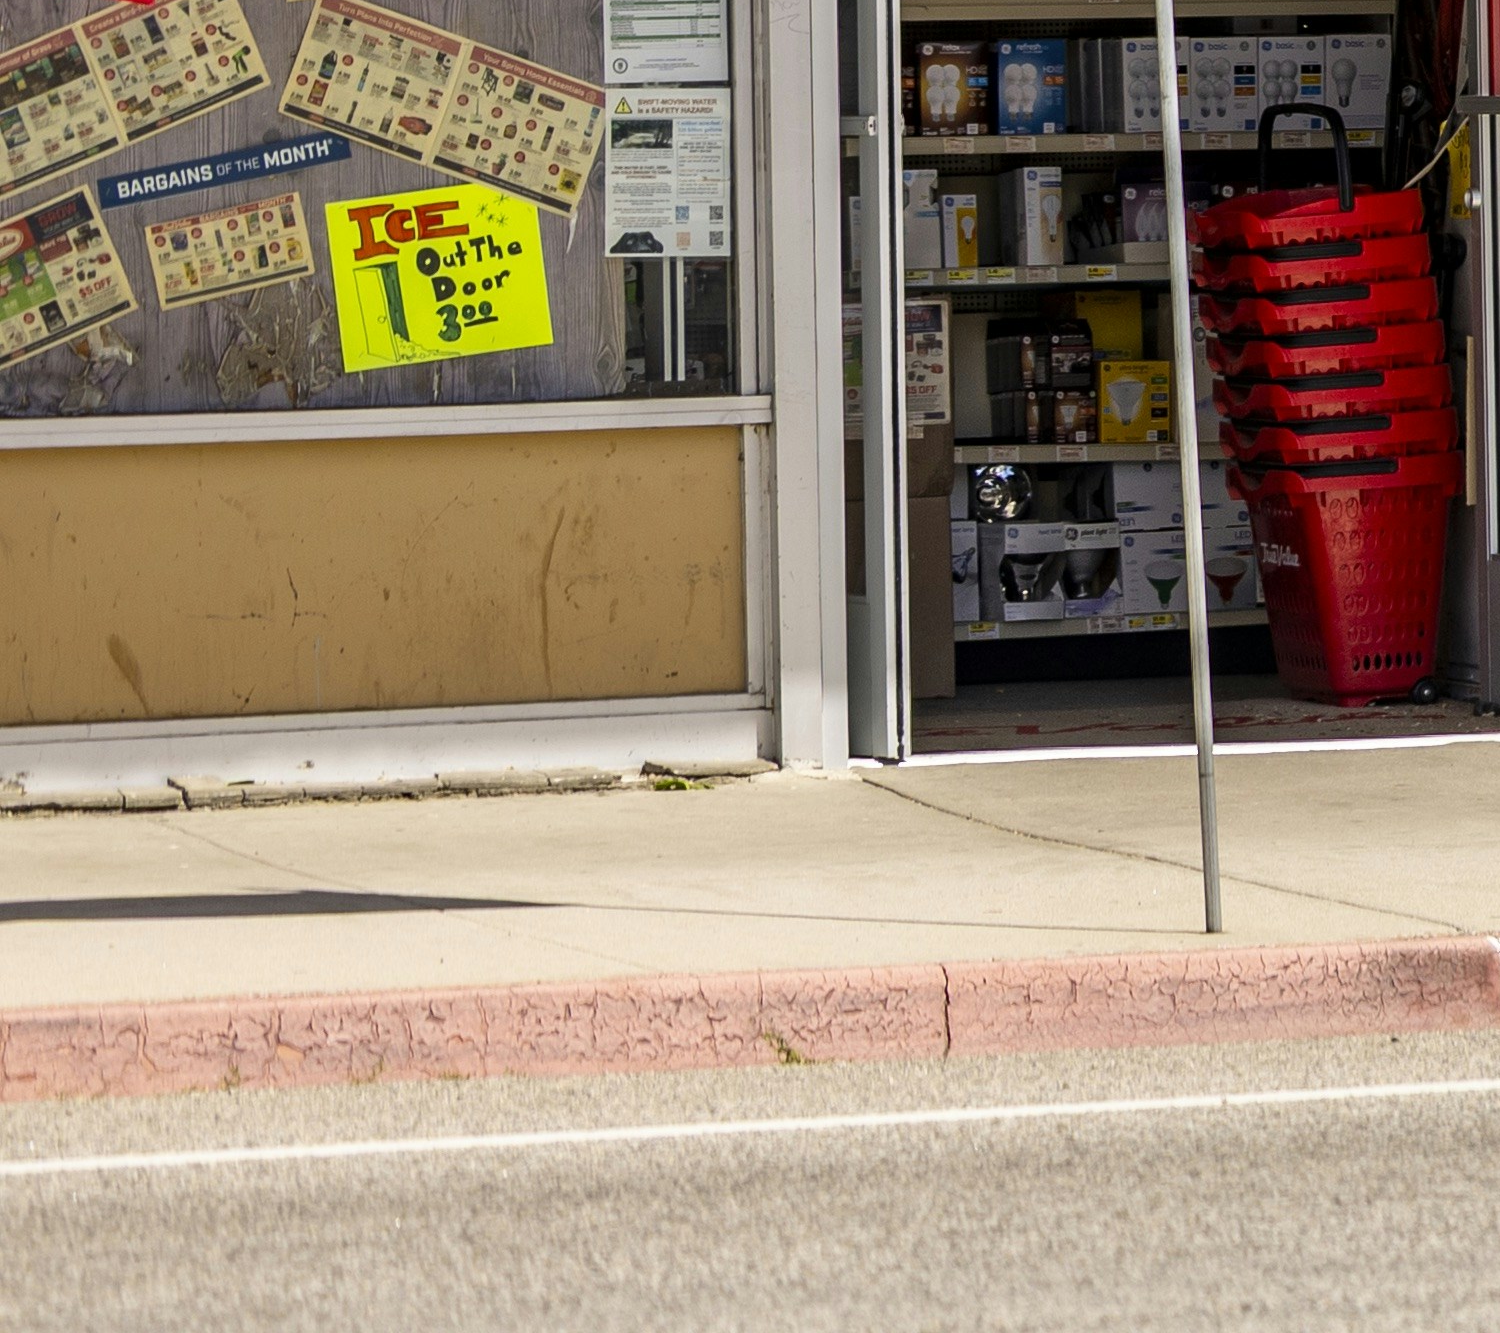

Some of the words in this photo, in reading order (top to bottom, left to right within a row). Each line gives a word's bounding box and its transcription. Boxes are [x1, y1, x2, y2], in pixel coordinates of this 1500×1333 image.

[116, 164, 213, 199] BARGAINS
[216, 161, 233, 177] OF
[237, 156, 261, 173] THE
[263, 140, 329, 169] MONTH
[347, 201, 470, 262] ICE
[416, 241, 468, 277] Out
[468, 234, 523, 264] The
[431, 269, 511, 303] Door
